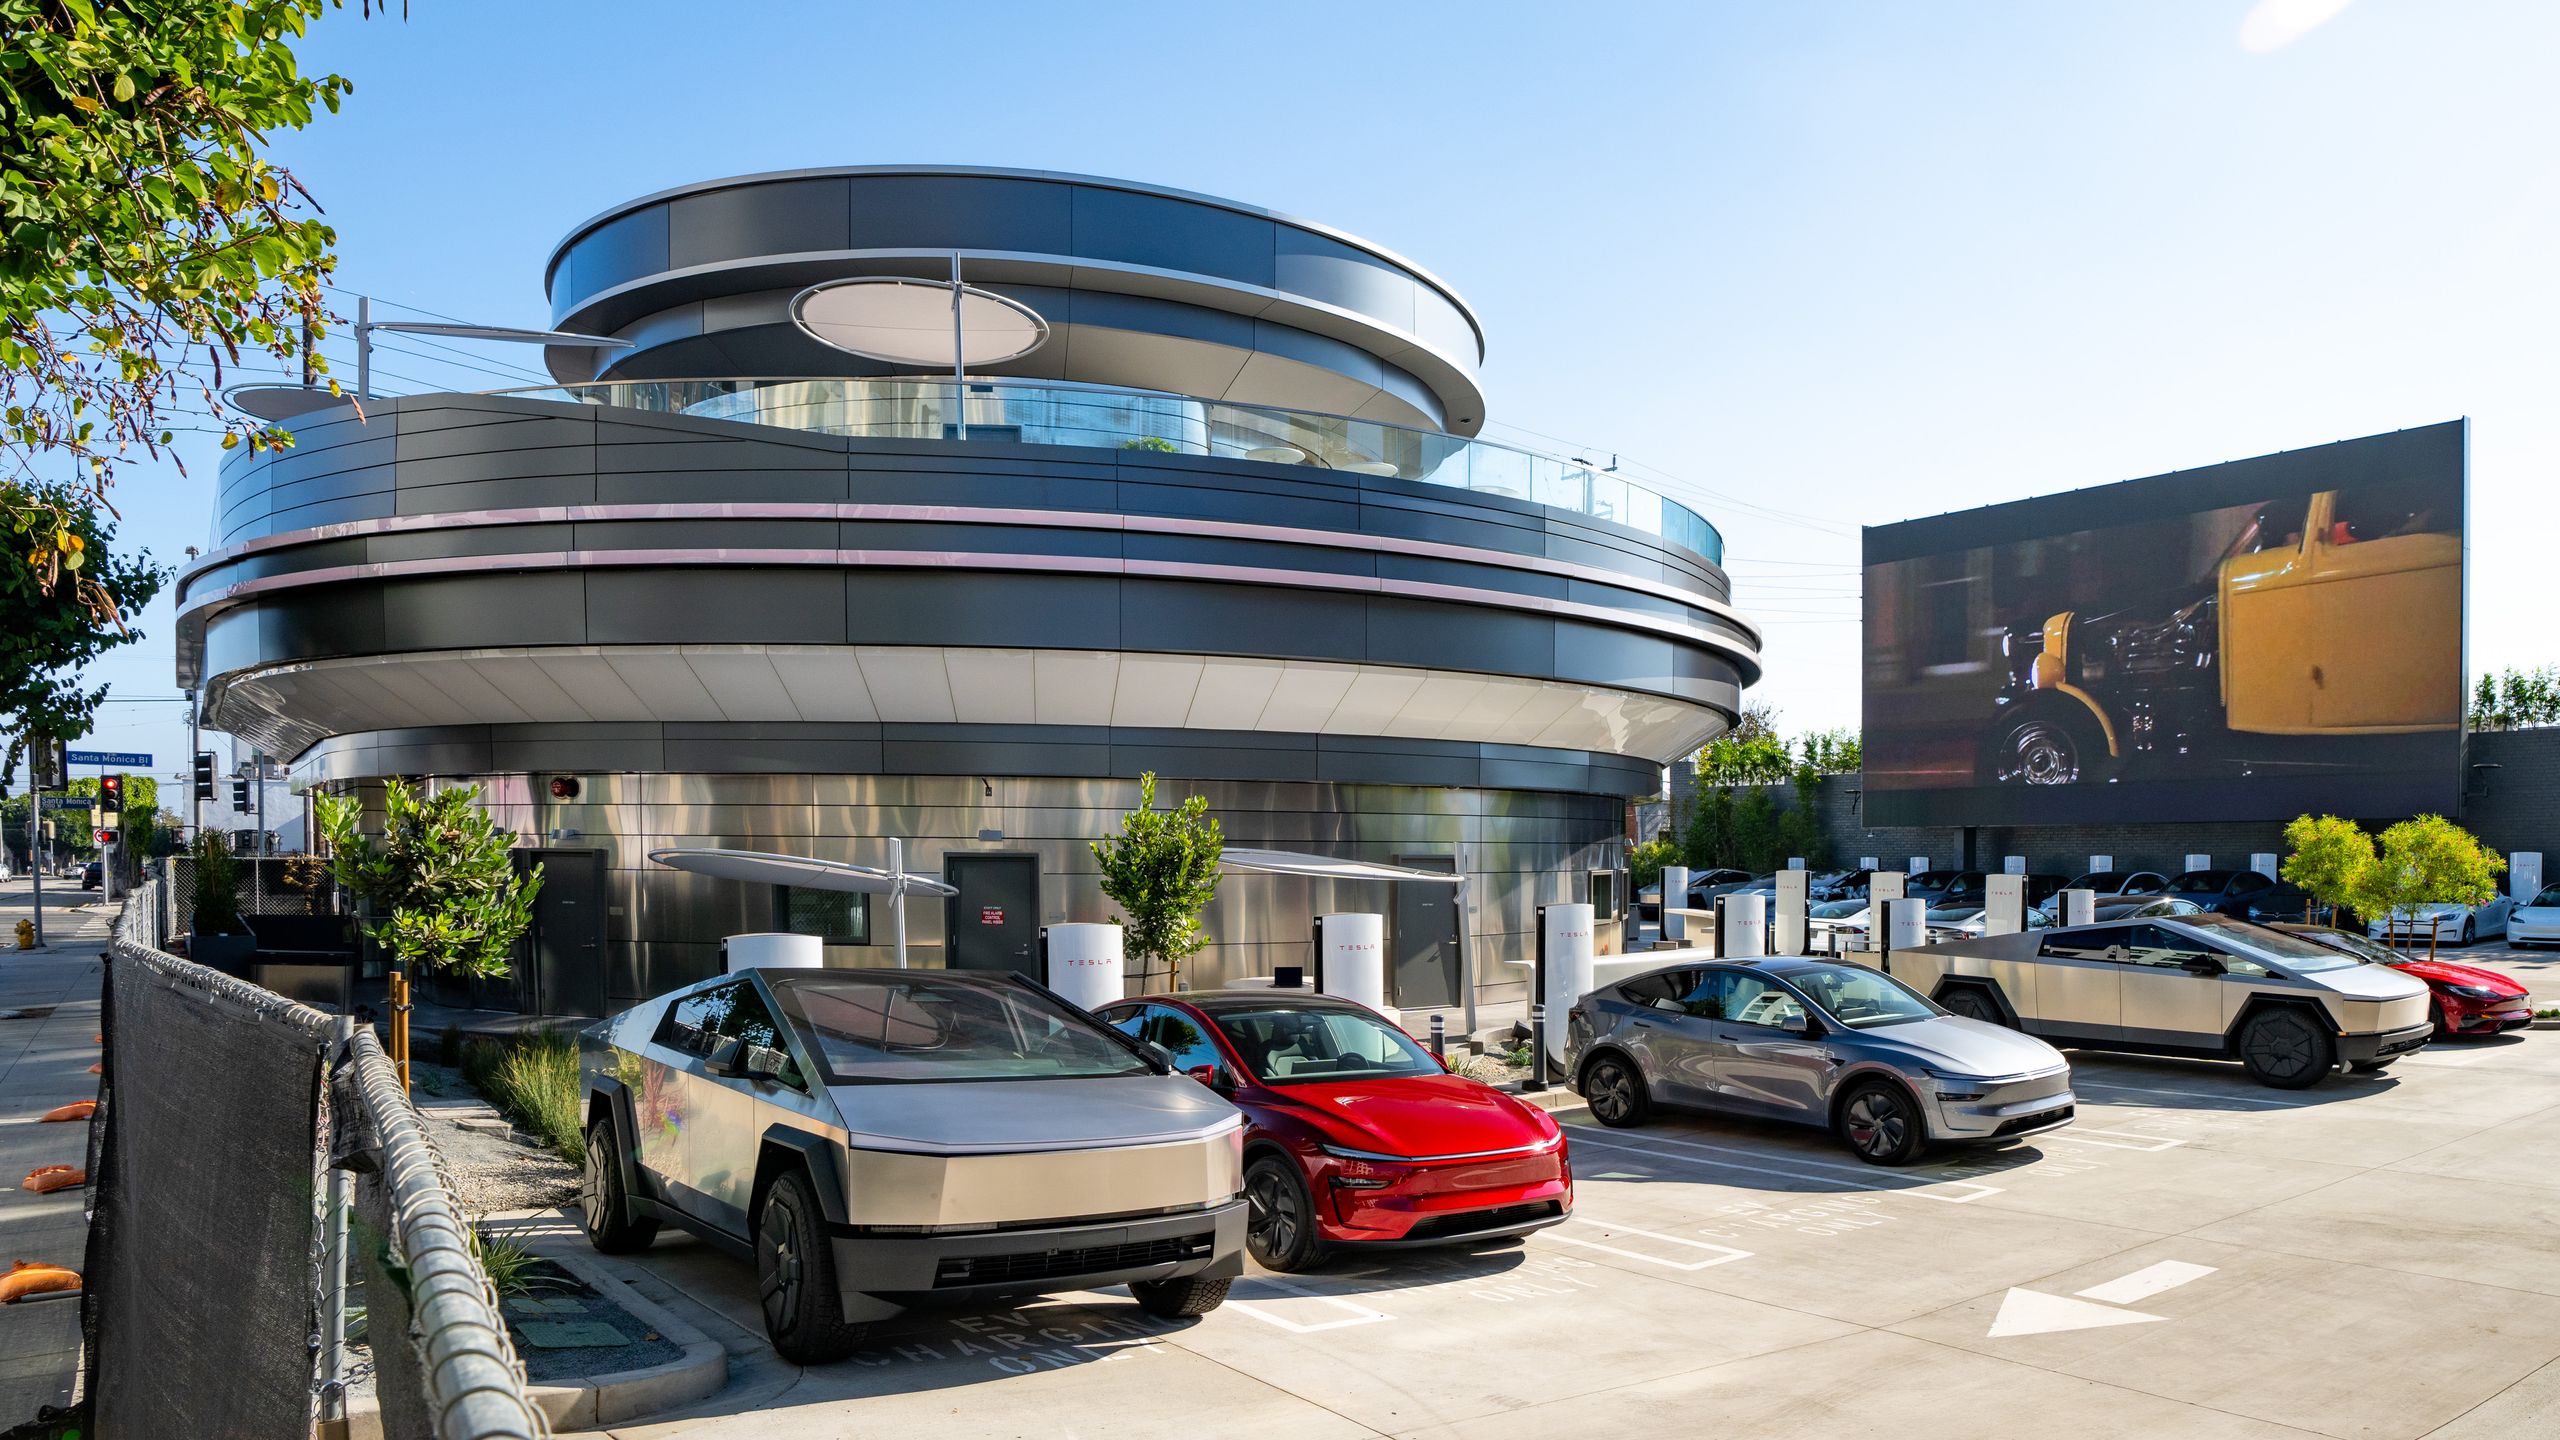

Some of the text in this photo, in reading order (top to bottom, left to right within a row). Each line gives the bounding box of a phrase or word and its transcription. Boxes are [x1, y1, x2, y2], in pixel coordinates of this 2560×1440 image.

[71, 753, 99, 762] Santa
[102, 754, 136, 763] Monica
[42, 797, 91, 805] Santa Monica
[1068, 958, 1112, 966] TESLA
[1797, 1210, 1897, 1236] ONLY
[1469, 1275, 1598, 1302] ONLY
[948, 1309, 1031, 1333] EV
[988, 1338, 1167, 1374] ONLY
